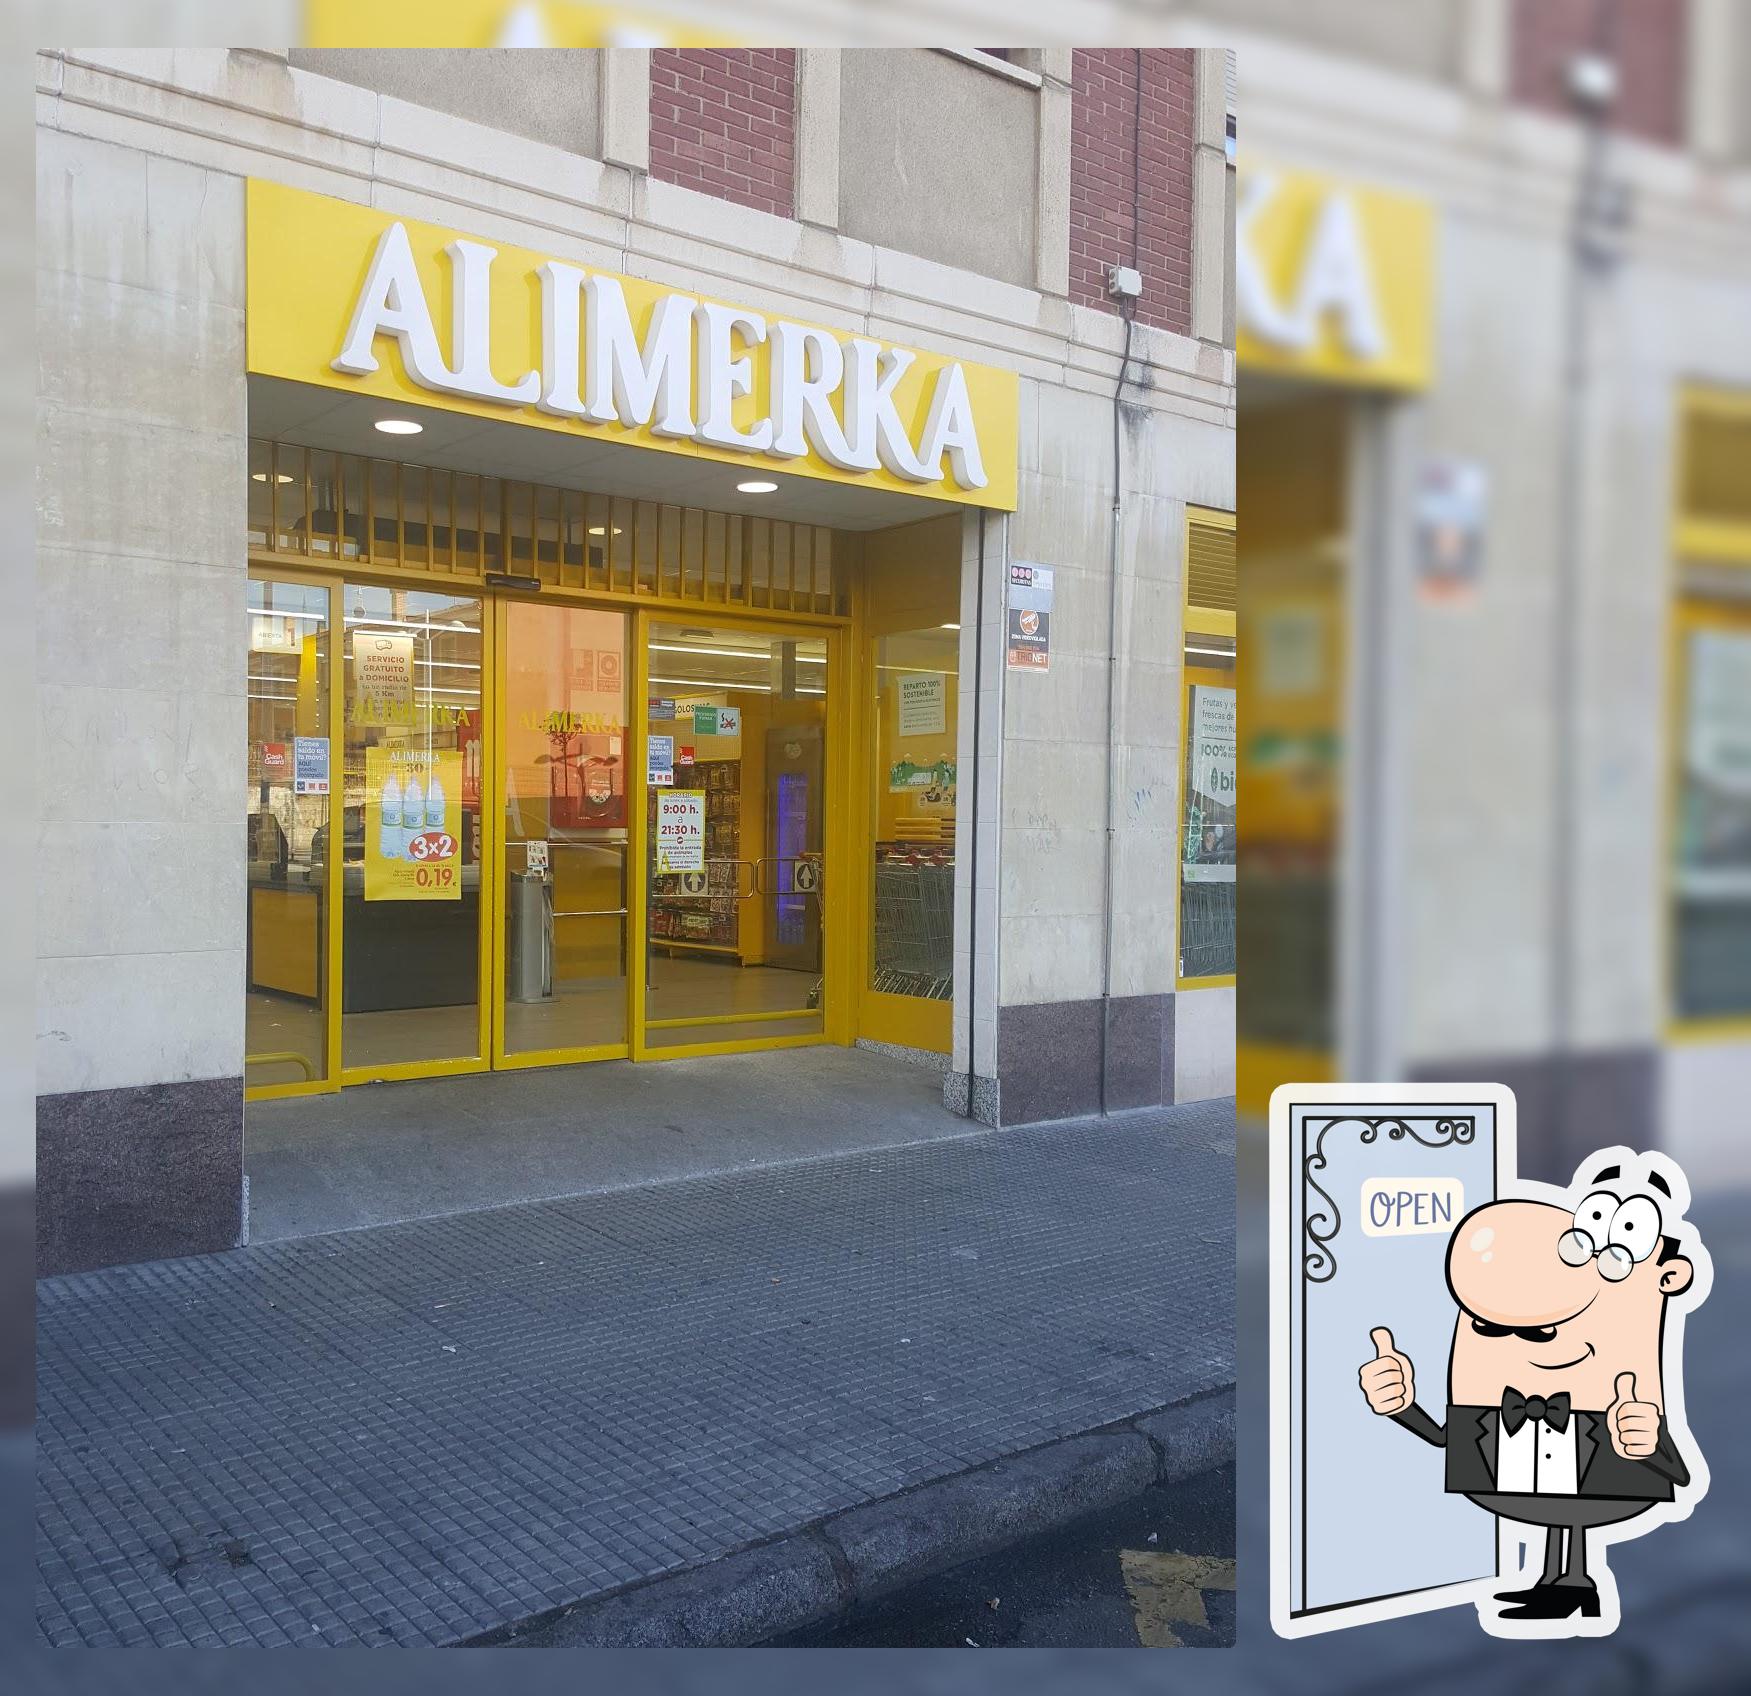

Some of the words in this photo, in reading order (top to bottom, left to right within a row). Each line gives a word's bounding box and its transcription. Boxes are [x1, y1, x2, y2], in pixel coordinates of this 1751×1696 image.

[331, 221, 989, 491] ALIMERKA
[366, 655, 405, 664] SERVICIO
[363, 664, 405, 673] GRATUITO
[365, 674, 409, 683] DOMICILIO
[903, 681, 927, 690] REPARTO
[903, 689, 935, 699] SOSTENIBLE
[1202, 697, 1223, 708] Frutas
[1202, 709, 1225, 720] frescas
[1202, 723, 1227, 733] mejores
[1220, 770, 1236, 792] bi
[663, 804, 687, 814] 9:00
[690, 804, 699, 814] h.
[661, 825, 688, 835] 21:30
[690, 825, 700, 835] h.
[414, 835, 453, 858] 3x2
[416, 868, 453, 887] 0,19
